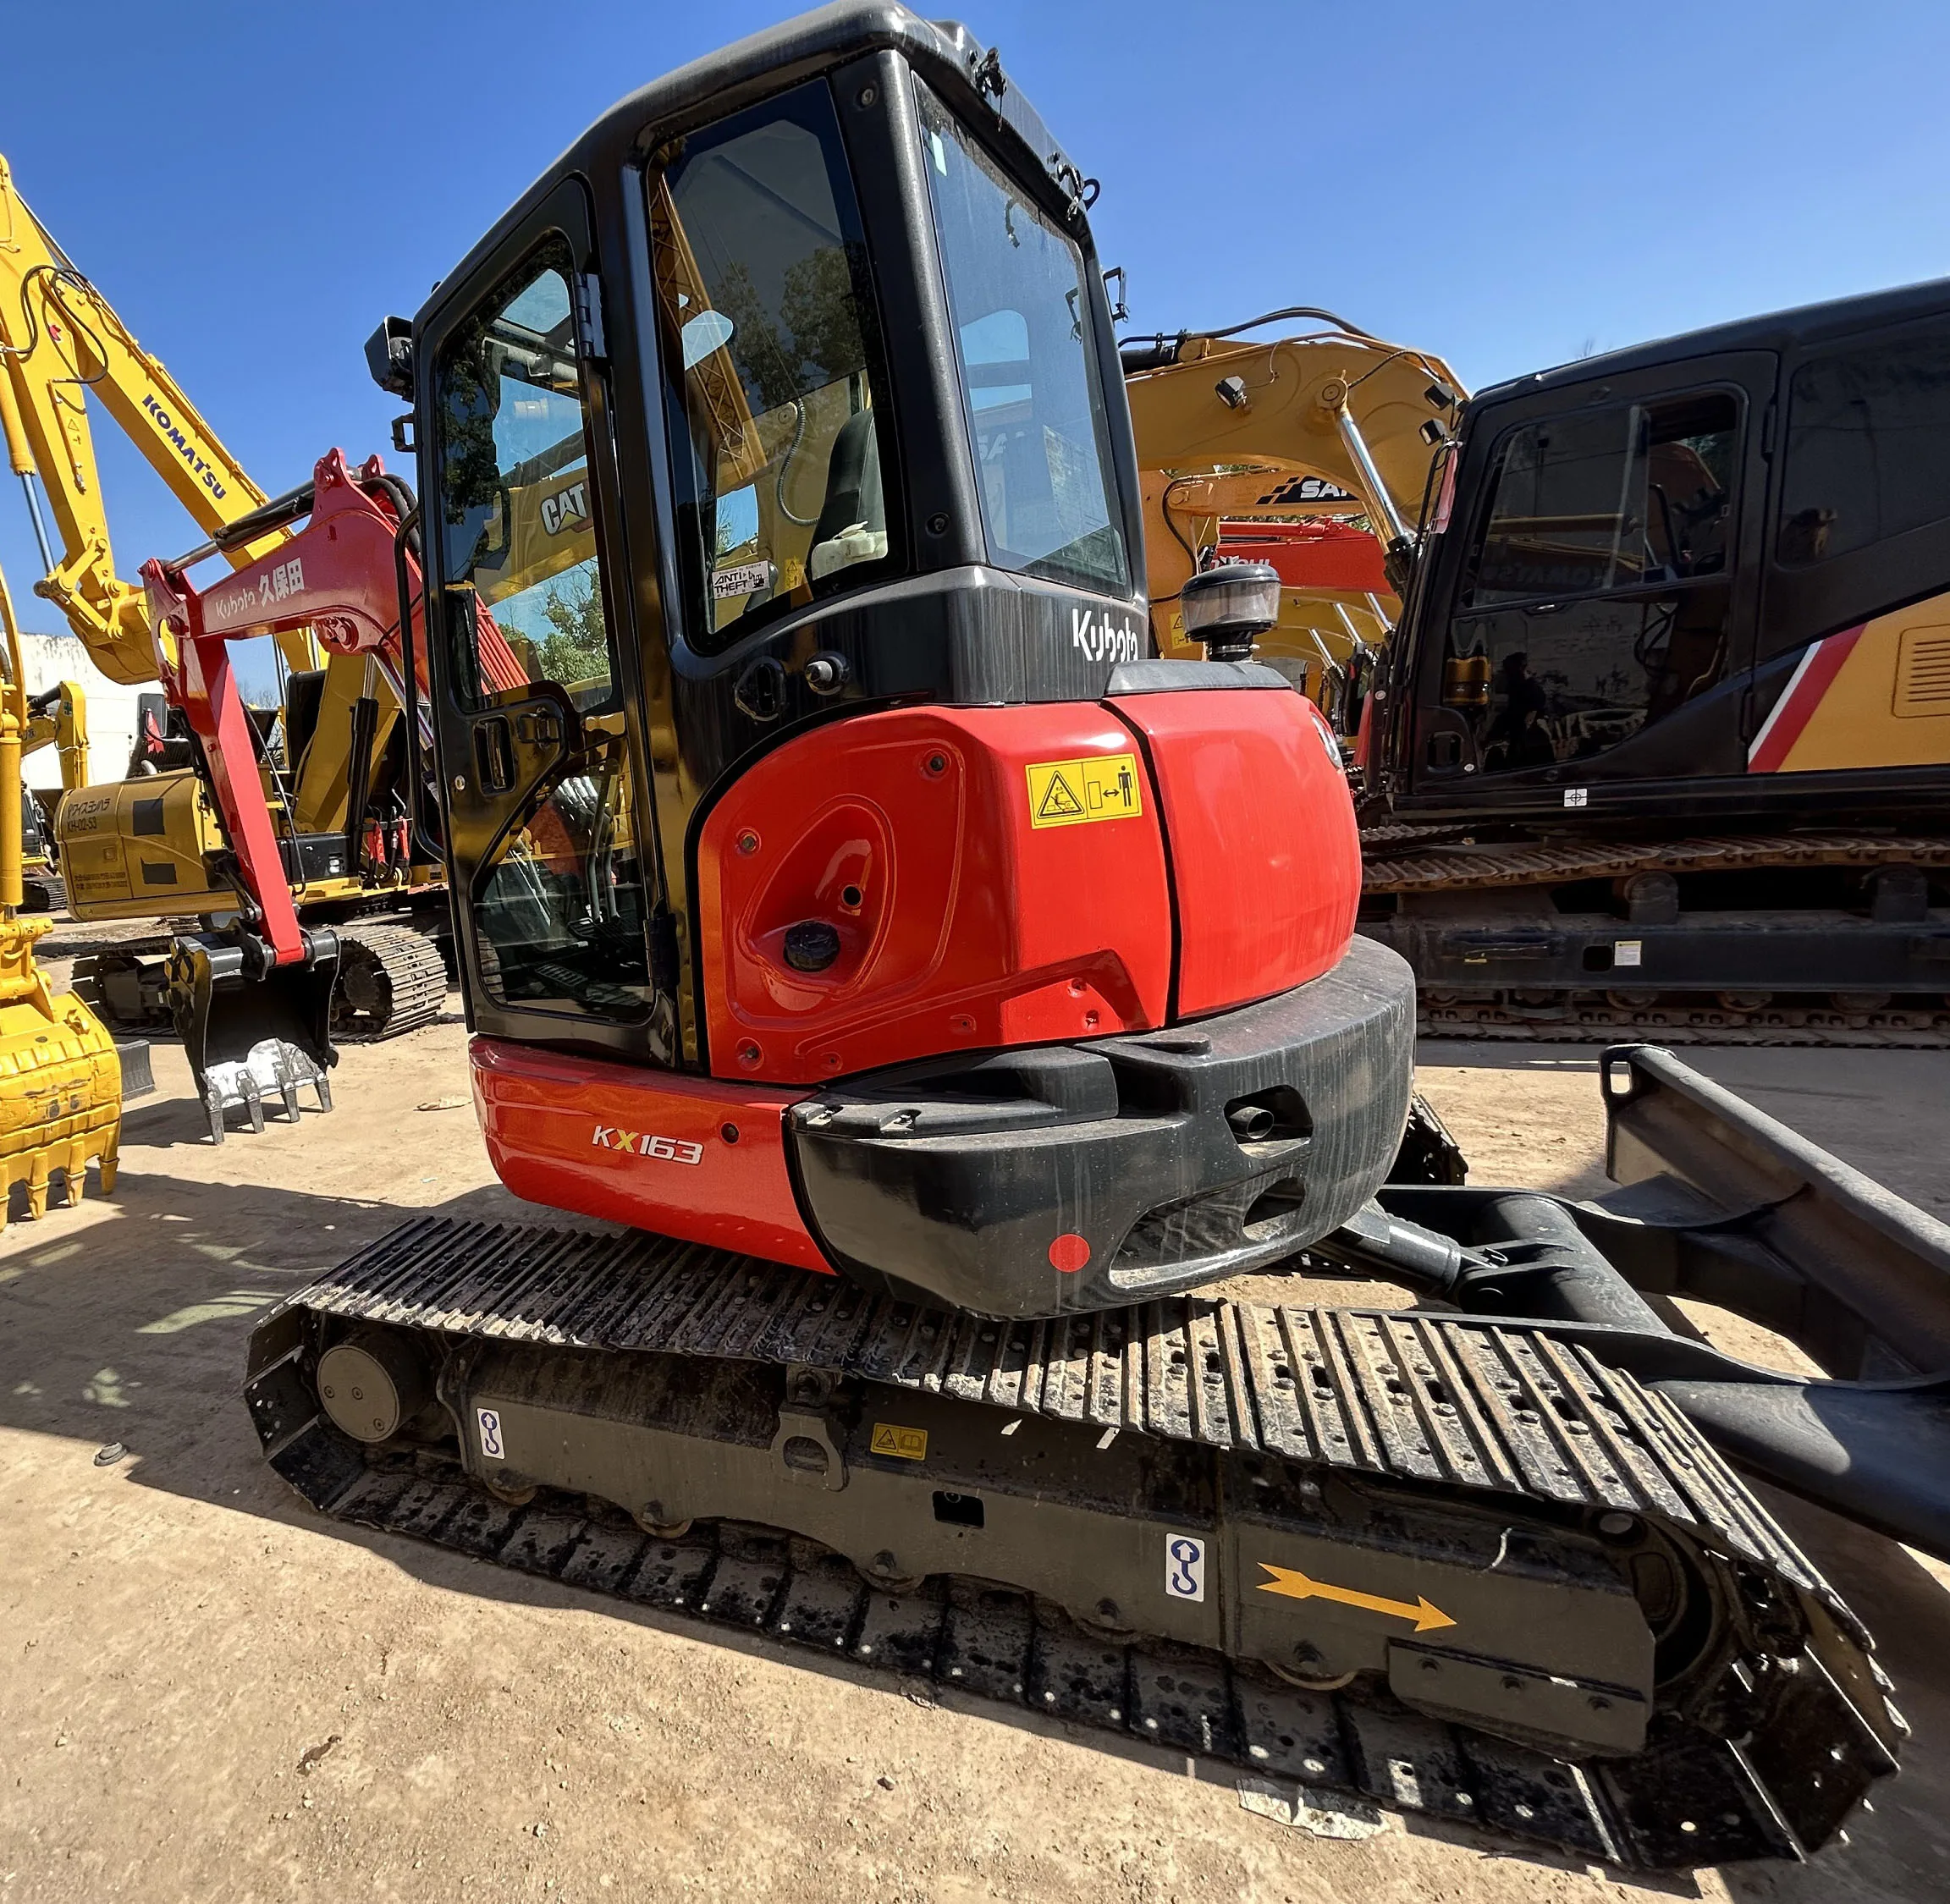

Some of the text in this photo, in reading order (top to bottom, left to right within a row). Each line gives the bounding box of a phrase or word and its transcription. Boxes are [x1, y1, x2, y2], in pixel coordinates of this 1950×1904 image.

[142, 393, 227, 499] KOMATSU
[542, 482, 587, 535] CAT
[216, 557, 305, 619] Kubota 久保田
[713, 579, 748, 594] THEFT
[1071, 608, 1139, 663] Kubota
[592, 1125, 704, 1165] KX163
